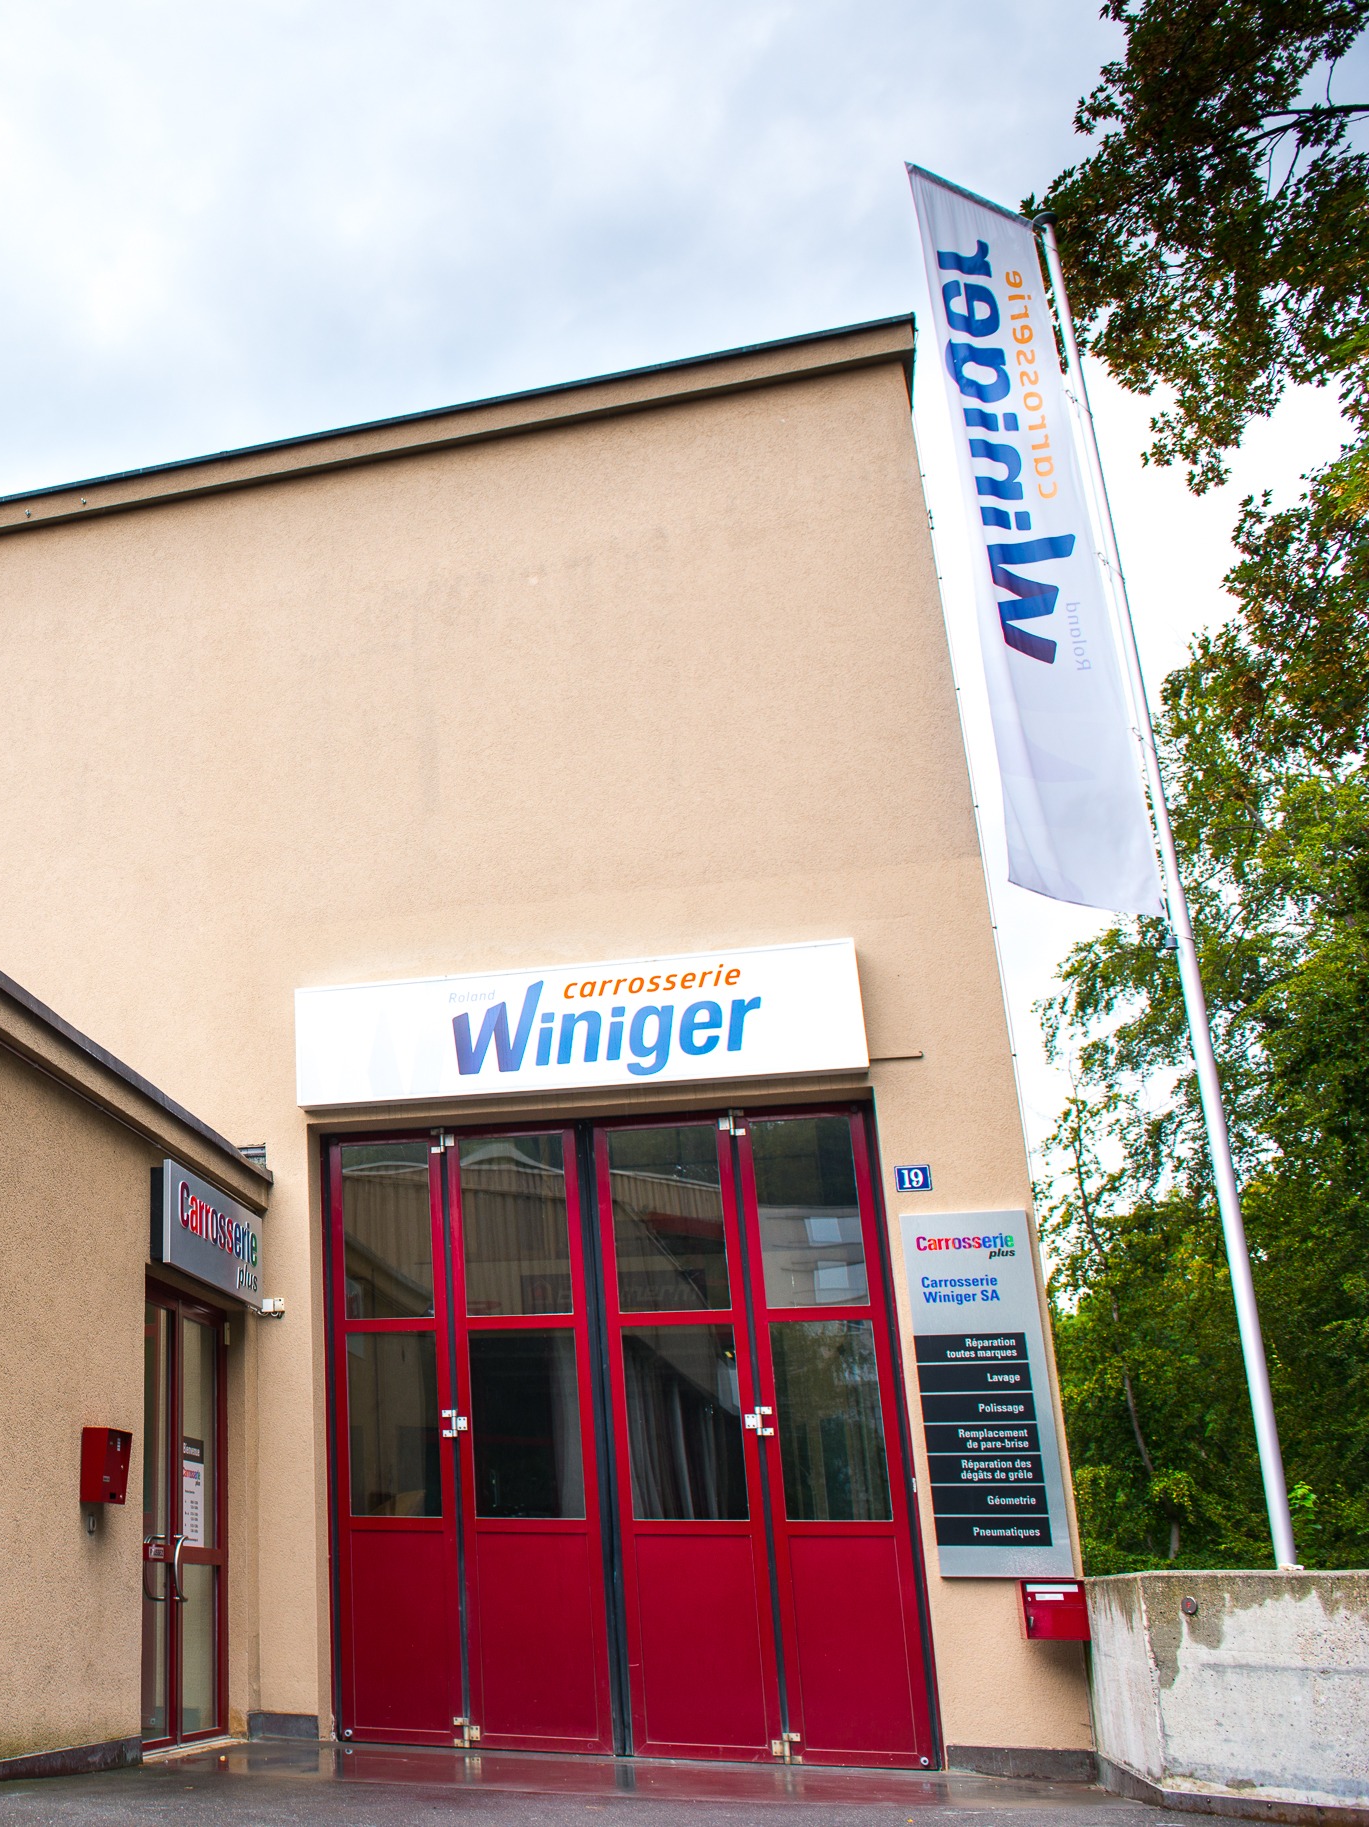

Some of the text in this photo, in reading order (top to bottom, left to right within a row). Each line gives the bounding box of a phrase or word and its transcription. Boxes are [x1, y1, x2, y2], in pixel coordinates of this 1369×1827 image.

[563, 963, 741, 1000] carrosserie
[448, 989, 496, 1004] Roland
[451, 980, 762, 1077] Winiger
[901, 1169, 924, 1188] 19
[178, 1180, 258, 1268] Carrosserie
[915, 1233, 1015, 1252] Carrosserie
[988, 1248, 1016, 1260] plus
[236, 1264, 258, 1293] plus
[921, 1274, 999, 1289] Carrosserie
[923, 1289, 1001, 1305] Winiger SA
[965, 1337, 1016, 1349] Réparation
[946, 1349, 1018, 1359] toutes marques
[987, 1373, 1021, 1383] Lavage
[978, 1403, 1025, 1414] Polissage
[958, 1428, 1029, 1440] Remplacement
[967, 1439, 1029, 1451] de pare-brise
[961, 1459, 1032, 1470] Réparation des
[961, 1470, 1033, 1481] dégâts de grêle
[987, 1495, 1037, 1505] Géometrie
[973, 1526, 1041, 1539] Pneumatiques
